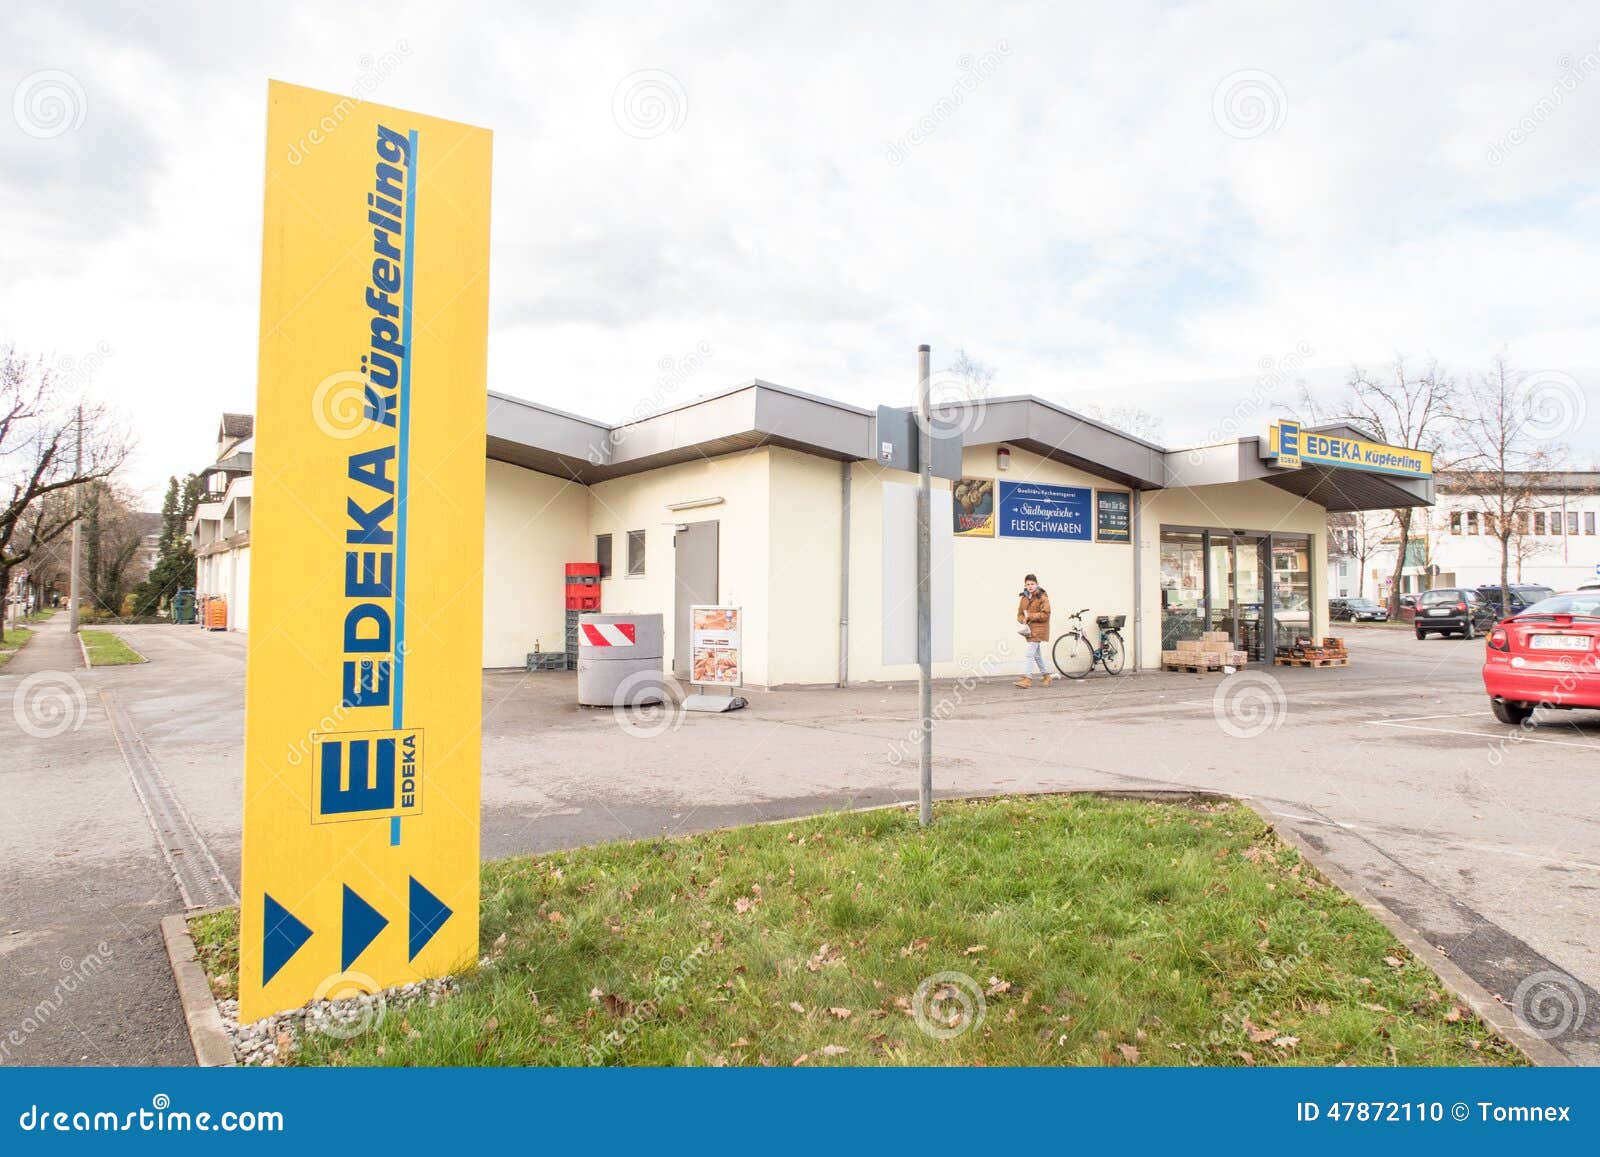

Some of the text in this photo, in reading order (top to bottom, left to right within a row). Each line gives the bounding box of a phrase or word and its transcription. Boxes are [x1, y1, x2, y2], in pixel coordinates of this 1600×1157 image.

[342, 123, 411, 708] EDEKA Küpferling
[1280, 424, 1298, 456] E
[1306, 435, 1422, 472] EDEKA Küpferling
[1011, 519, 1082, 534] FLEISCHWAREN
[1020, 502, 1073, 520] Südbayerische
[319, 737, 396, 815] E
[401, 734, 417, 808] EDEKA
